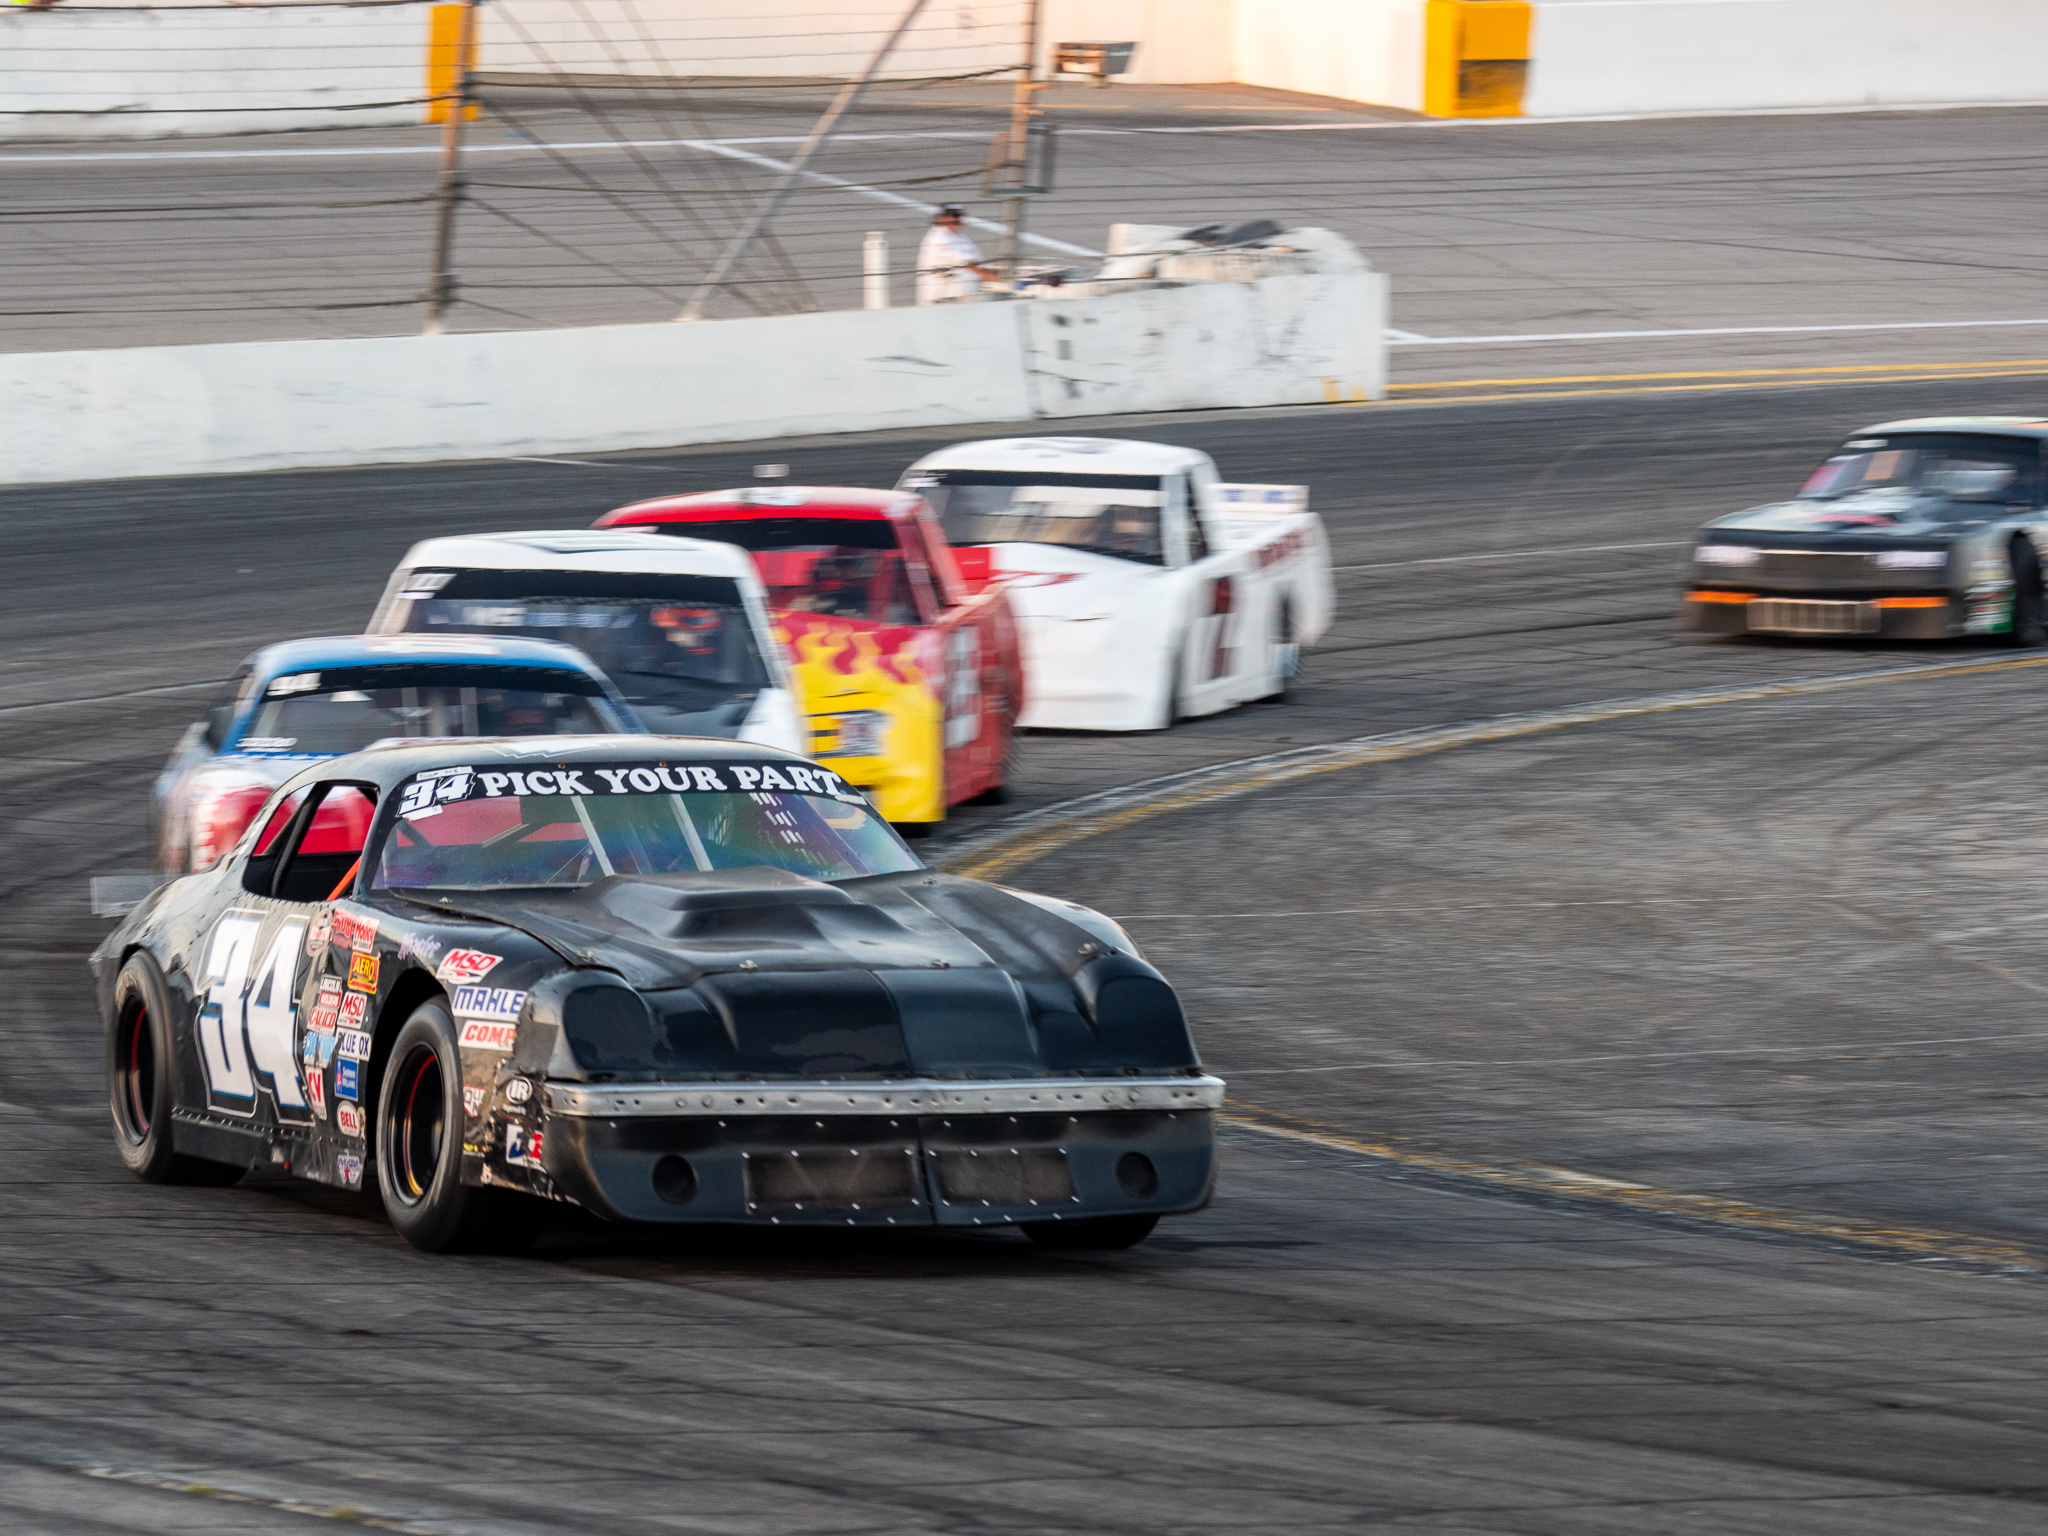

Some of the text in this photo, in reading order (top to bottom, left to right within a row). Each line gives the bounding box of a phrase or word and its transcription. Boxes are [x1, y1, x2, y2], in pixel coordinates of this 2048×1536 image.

[477, 765, 841, 797] PICK YOUR PART
[398, 773, 472, 815] 34
[353, 956, 375, 981] AERO
[444, 950, 497, 971] MSD
[199, 914, 309, 1110] 34
[341, 994, 365, 1017] MSD
[453, 988, 524, 1014] MAHLE
[309, 1008, 337, 1029] CALICO
[358, 1035, 370, 1057] OX
[340, 1110, 358, 1130] BELL
